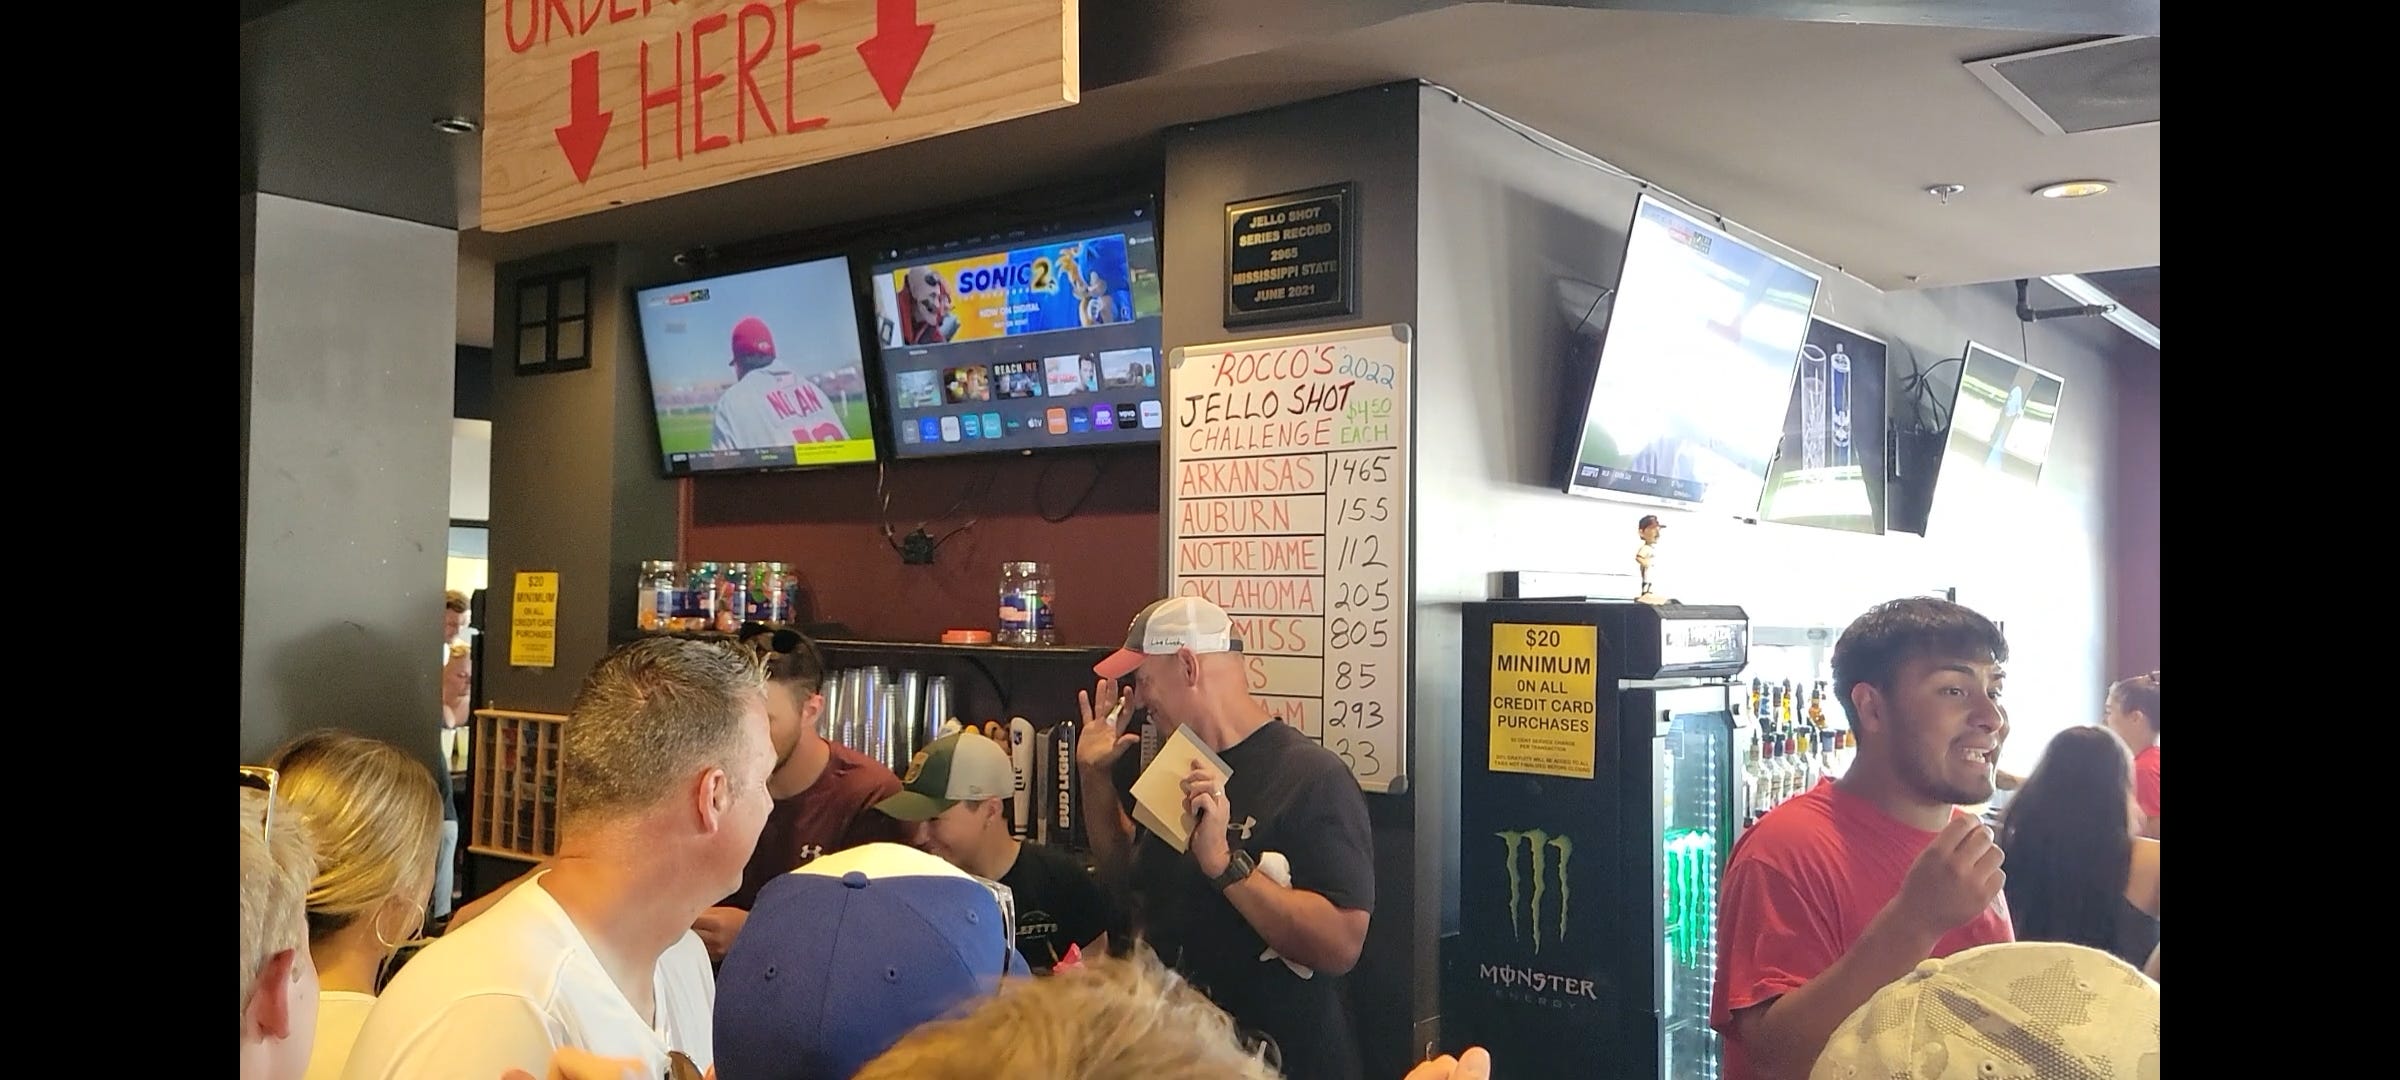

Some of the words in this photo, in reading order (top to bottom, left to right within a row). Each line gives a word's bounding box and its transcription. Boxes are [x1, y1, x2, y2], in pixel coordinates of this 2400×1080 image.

[640, 0, 830, 170] HERE
[1250, 212, 1286, 229] JELLO
[1288, 206, 1321, 222] SHOT
[1239, 230, 1280, 247] SERIES
[1283, 223, 1332, 241] RECORD
[1270, 248, 1298, 262] 2965
[959, 262, 1031, 294] SONIC
[1034, 260, 1049, 289] 2
[1233, 265, 1299, 286] MISSISSIPPI
[1302, 260, 1337, 277] STATE
[1254, 288, 1286, 303] JUNE
[1288, 284, 1316, 298] 2021
[994, 363, 1023, 376] REACH
[1215, 346, 1335, 387] ROCCO'S
[1340, 354, 1395, 390] 2022
[1181, 390, 1279, 428] JELLO
[1287, 380, 1355, 415] SHOT
[1189, 417, 1333, 452] CHALLENGE
[1341, 424, 1389, 445] EACH
[1181, 456, 1315, 496] ARKANSAS
[1330, 456, 1391, 487] 1465
[1181, 499, 1291, 534] AUBURN
[1337, 497, 1389, 526] 155
[1180, 541, 1257, 572] NOTRE
[1262, 539, 1320, 571] DAME
[1338, 535, 1389, 571] 112
[1334, 577, 1390, 612] 205
[1234, 618, 1307, 651] MISS
[1330, 617, 1388, 650] 805
[1526, 628, 1560, 650] $20
[1335, 661, 1376, 690] 85
[1498, 654, 1590, 675] MINIMUM
[1539, 681, 1568, 694] ALL
[1329, 700, 1384, 730] 293
[1493, 696, 1547, 711] CREDIT
[1551, 700, 1594, 714] CARD
[1497, 715, 1589, 733] PURCHASES
[1058, 738, 1070, 790] LIGHT
[1059, 791, 1070, 829] BUD
[1480, 963, 1598, 1000] MONSTER
